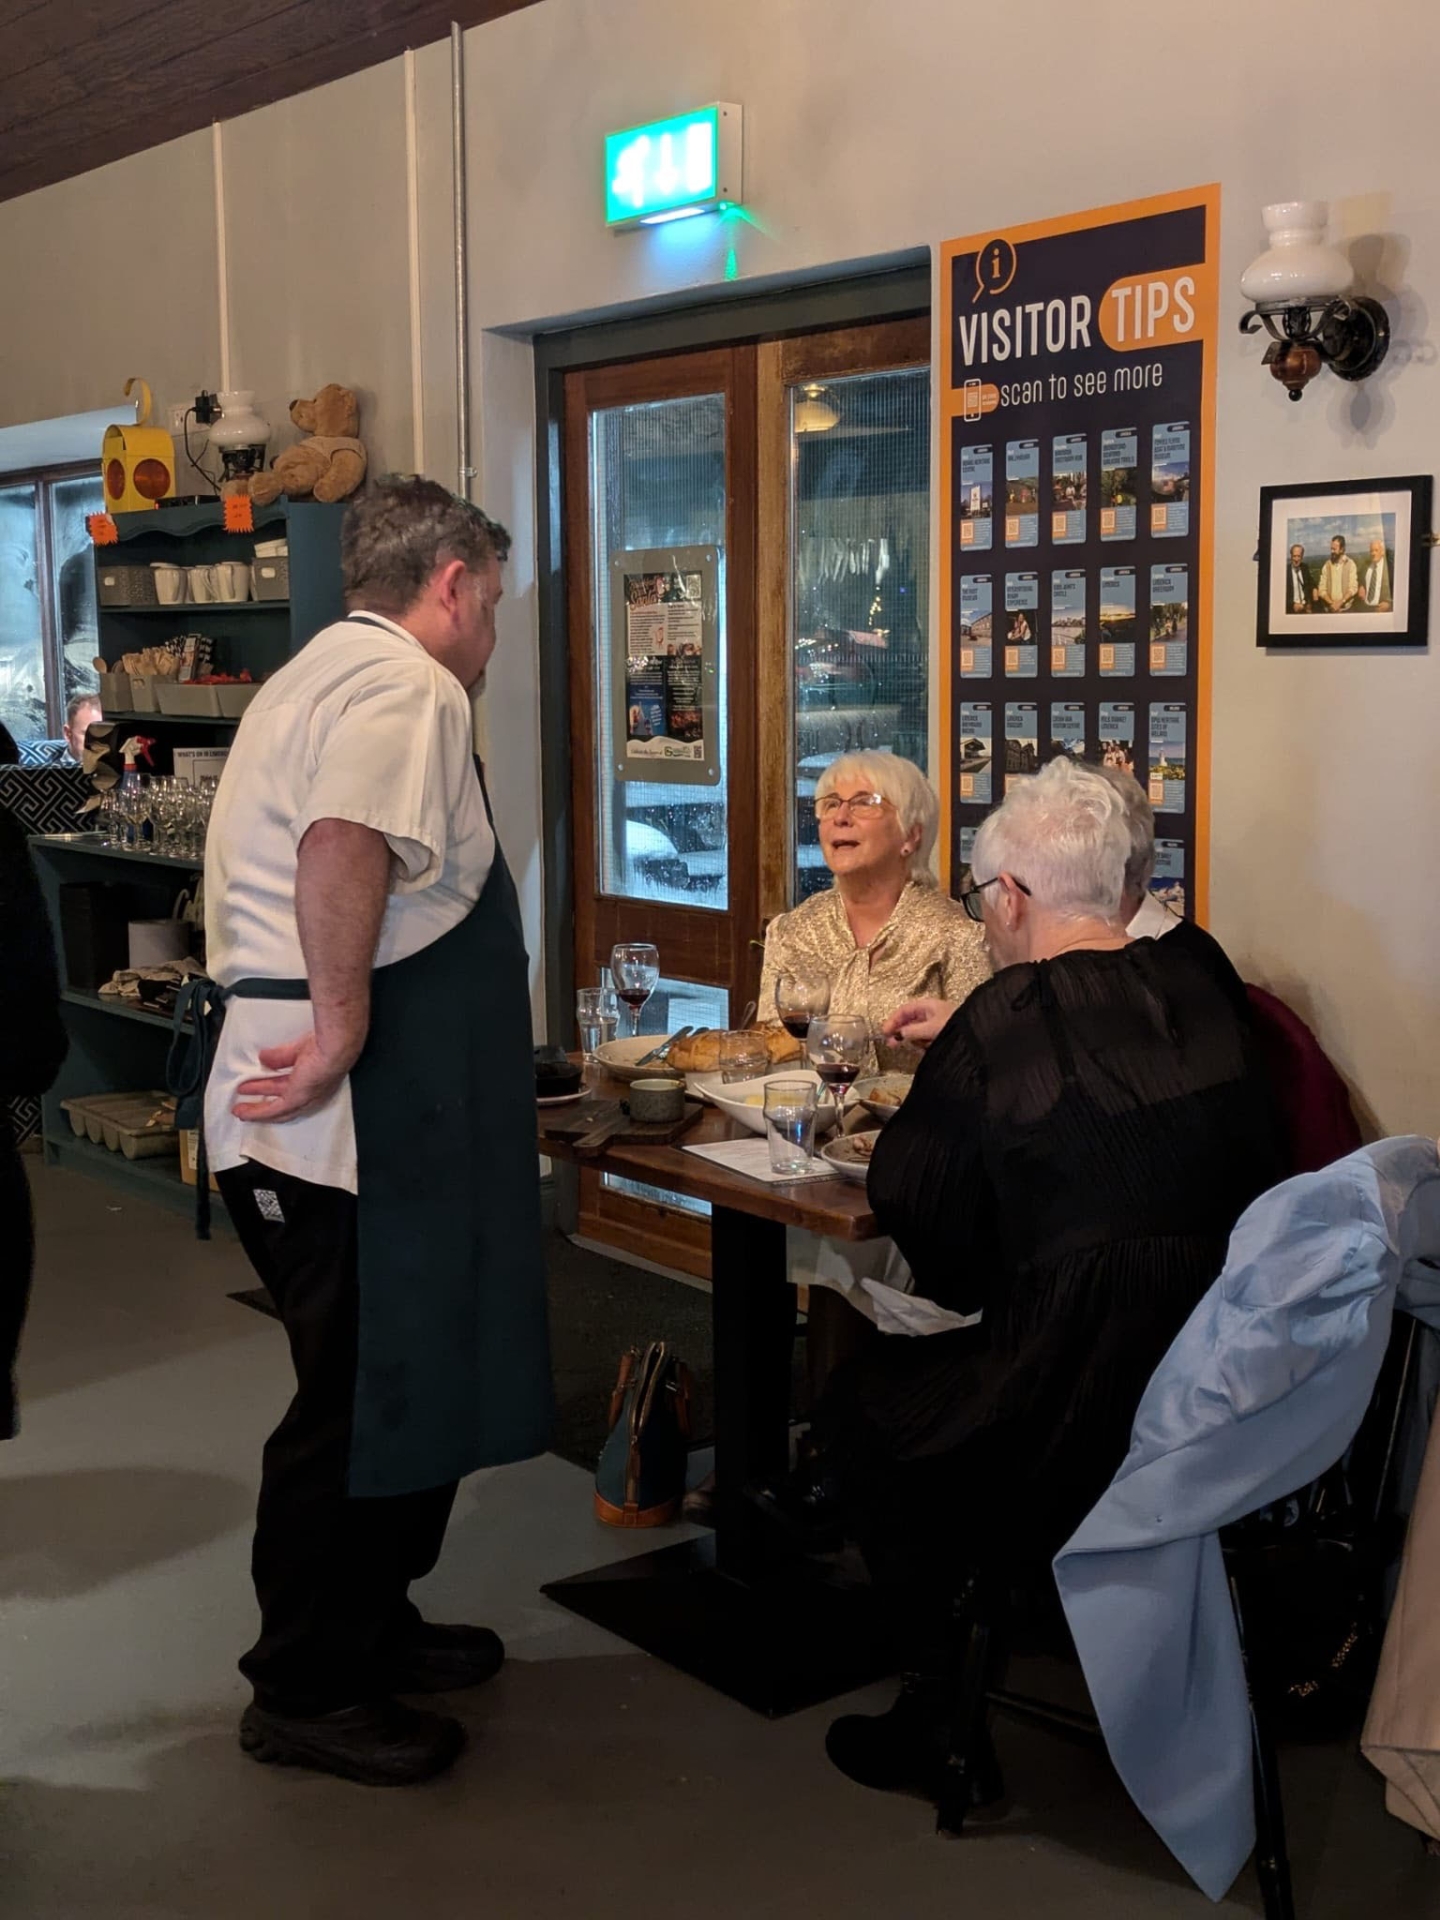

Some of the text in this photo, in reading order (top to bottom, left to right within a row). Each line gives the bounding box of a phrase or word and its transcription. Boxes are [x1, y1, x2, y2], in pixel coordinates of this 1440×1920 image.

[958, 276, 1195, 367] VISITOR TIPS
[1000, 383, 1043, 407] scan
[1049, 373, 1067, 400] to
[1074, 371, 1107, 398] see
[1114, 363, 1163, 392] more
